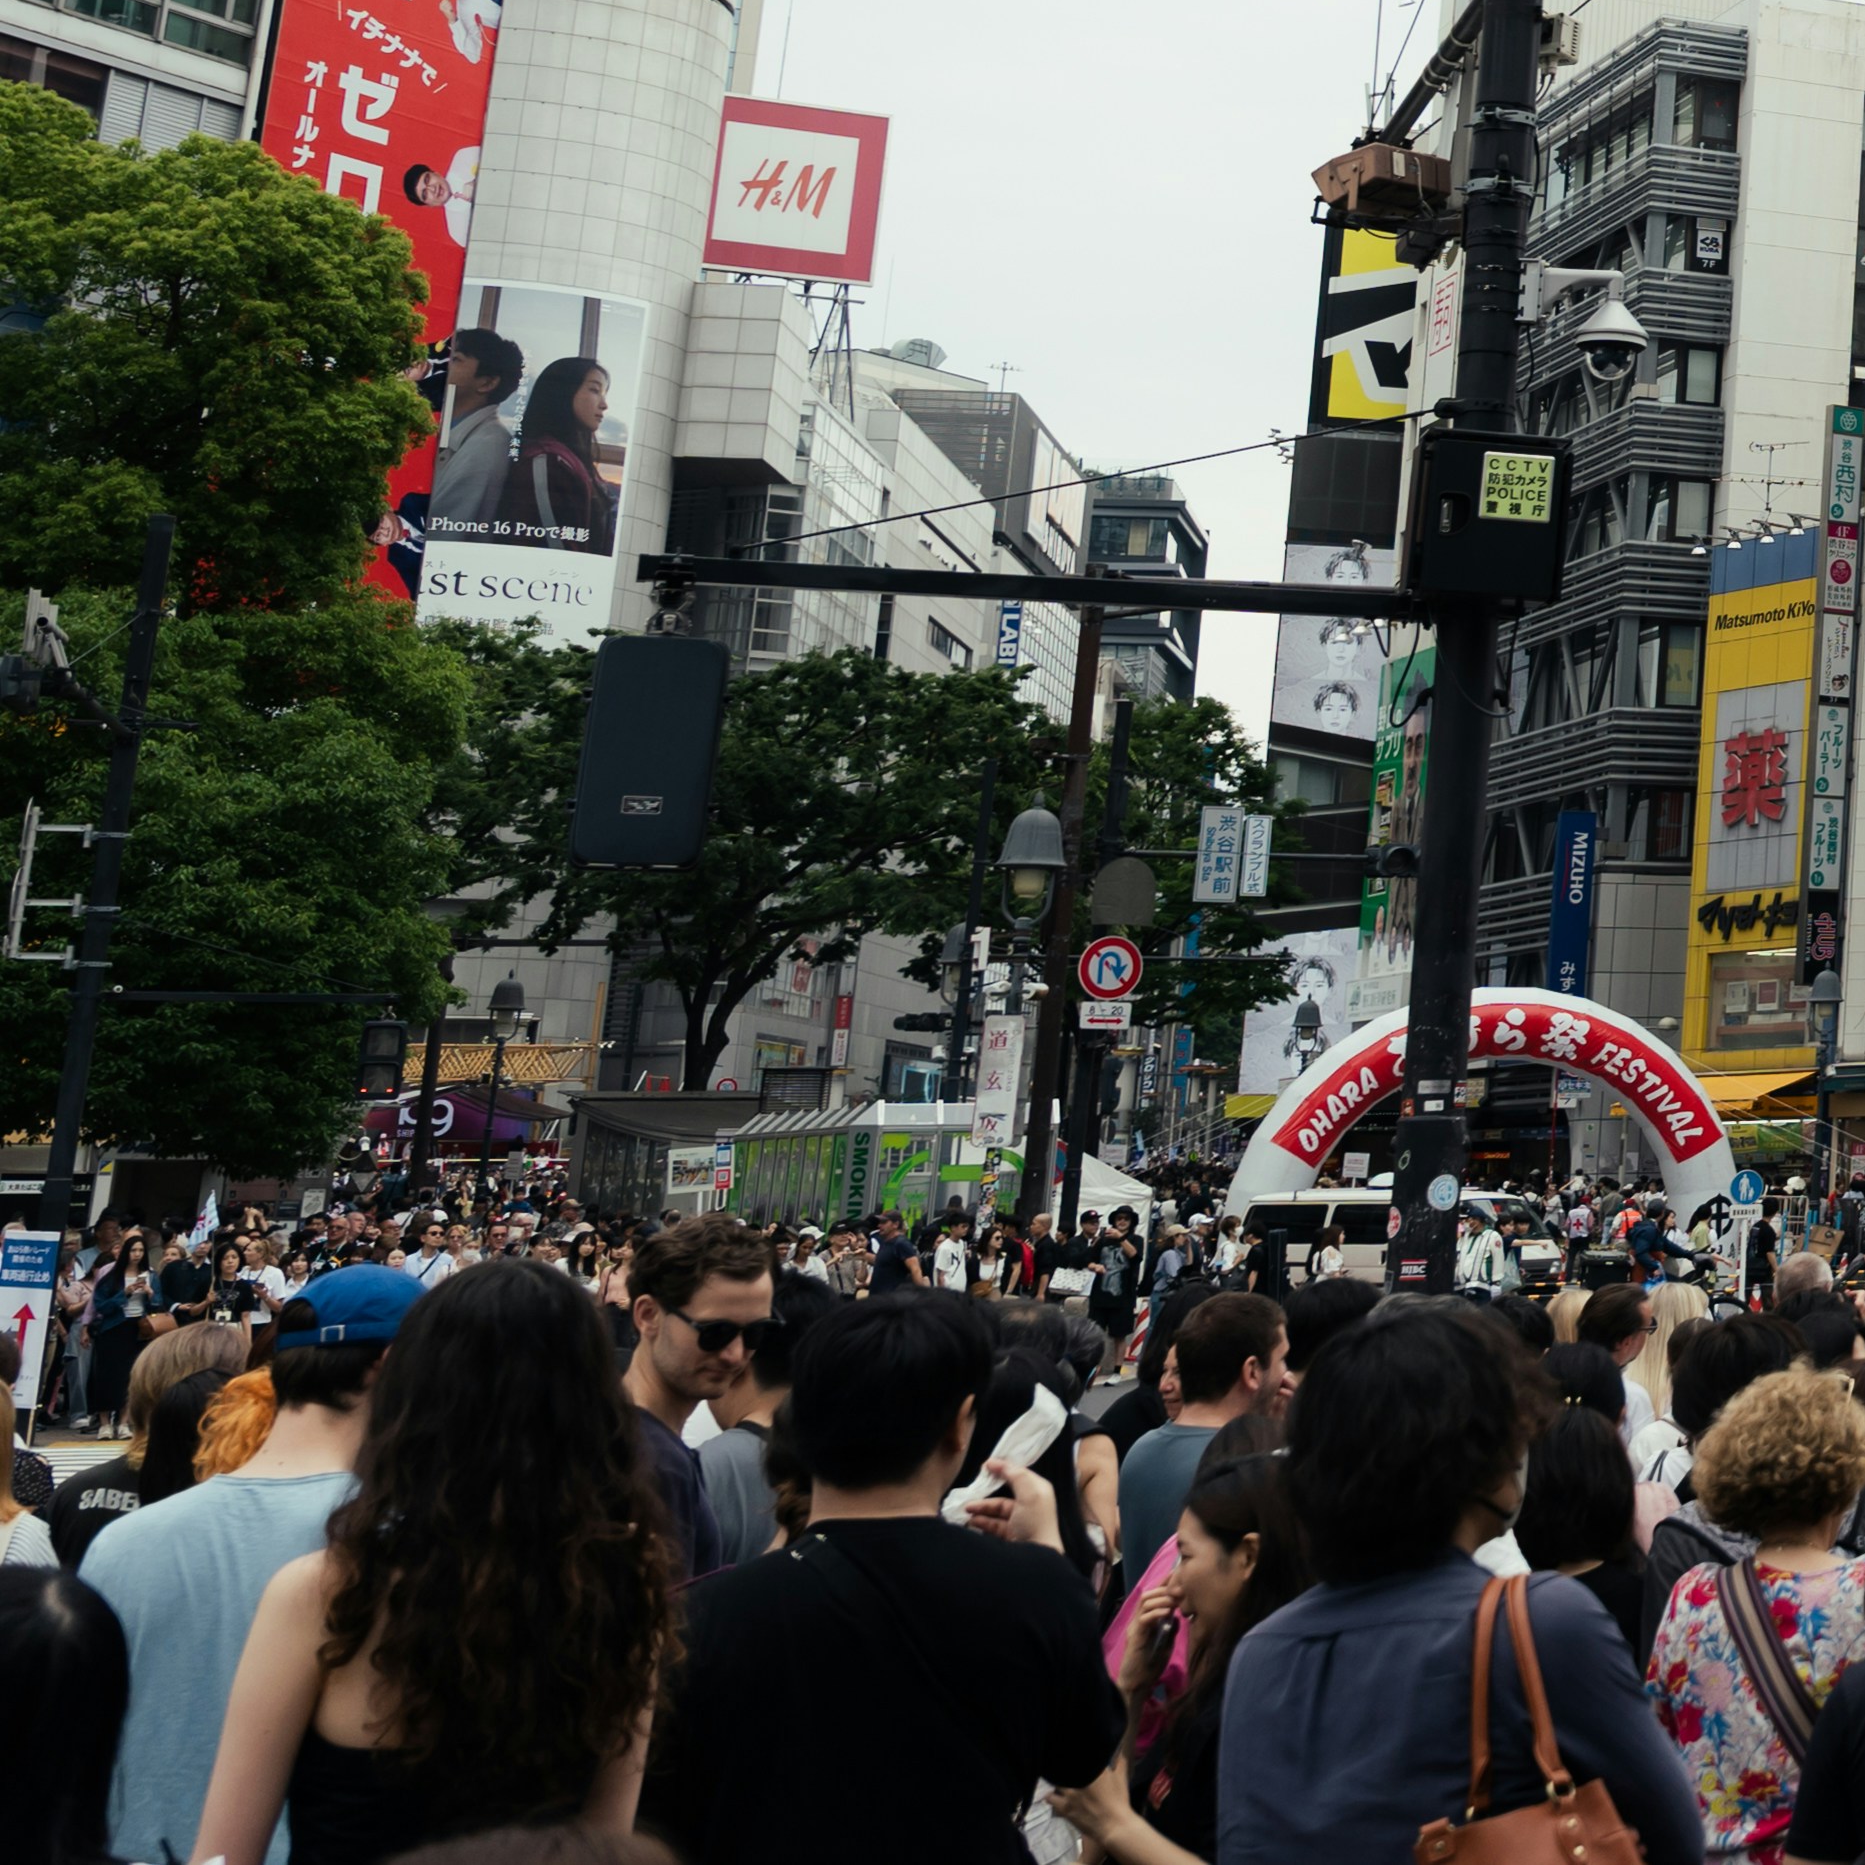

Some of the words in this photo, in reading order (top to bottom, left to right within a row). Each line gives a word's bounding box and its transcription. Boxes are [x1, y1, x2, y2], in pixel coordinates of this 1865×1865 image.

[346, 8, 440, 88] イチナナで
[738, 157, 838, 221] H&M
[1488, 473, 1548, 488] 防犯カメラ
[1489, 458, 1549, 474] CCTV
[1835, 439, 1857, 504] 渋谷西村
[1486, 501, 1546, 517] 警視庁
[1487, 487, 1547, 502] POLICE
[493, 520, 512, 536] 16
[514, 522, 590, 543] Proで撮影
[1829, 549, 1857, 560] クリニック
[1835, 525, 1851, 538] 4F
[478, 577, 594, 607] scene
[997, 612, 1020, 667] LABI
[1714, 603, 1786, 632] Matsumoto
[1820, 730, 1831, 769] パーラー
[1832, 724, 1844, 769] フルーツ
[1721, 727, 1789, 829] 薬
[1212, 814, 1238, 895] 渋谷駅前
[1246, 818, 1265, 894] スクランブル式
[1814, 823, 1826, 869] フルーツ
[1827, 816, 1839, 866] 渋谷西村
[1568, 831, 1590, 905] MIZUHO
[1811, 911, 1837, 962] HUB
[979, 1029, 1008, 1132] 道玄坂
[1591, 1042, 1704, 1147] FESTIVAL
[1298, 1066, 1379, 1153] OHARA
[1, 1268, 51, 1284] 車両通行止め
